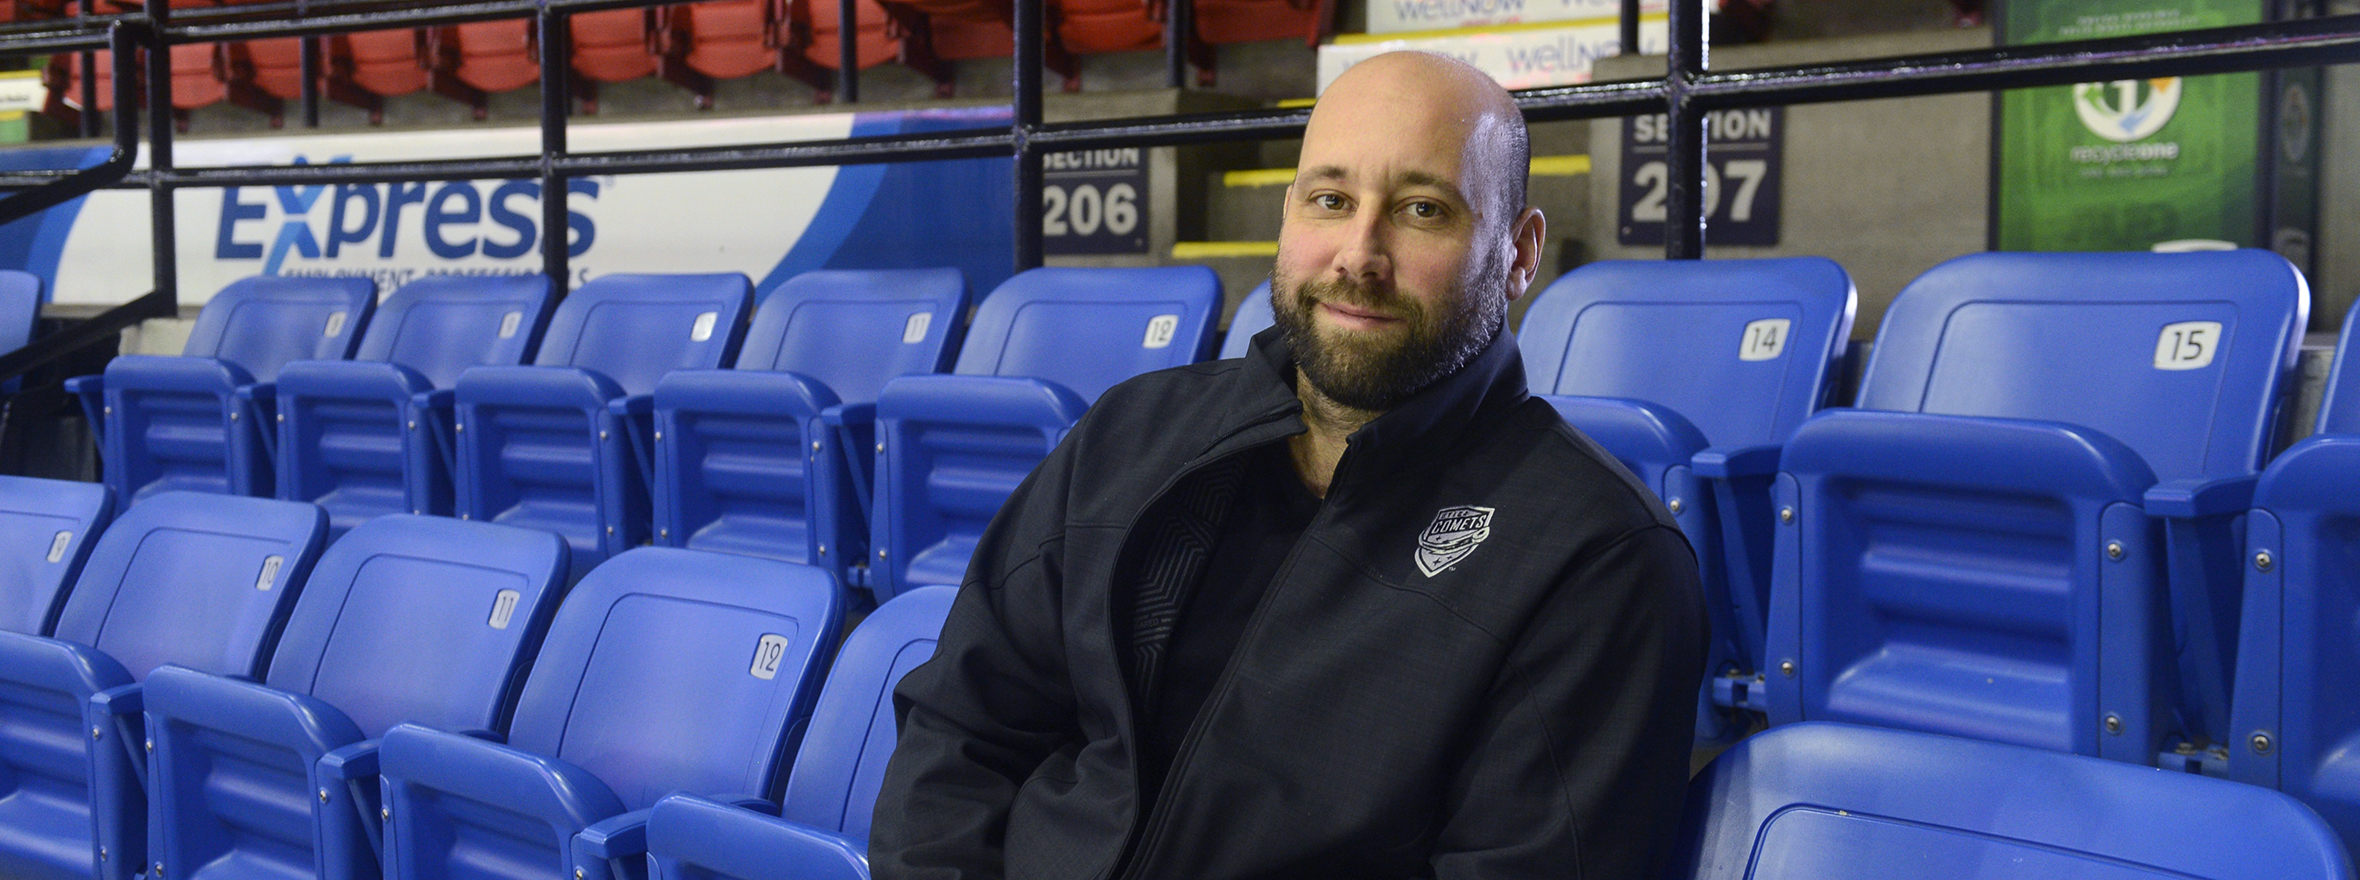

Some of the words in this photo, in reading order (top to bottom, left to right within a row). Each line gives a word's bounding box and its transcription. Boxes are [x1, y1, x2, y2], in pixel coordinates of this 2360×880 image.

[1505, 33, 1655, 73] wellN
[1634, 109, 1772, 143] SEION
[216, 155, 599, 276] Express
[1043, 183, 1138, 236] 206
[1151, 320, 1172, 342] 12
[1751, 326, 1777, 353] 14
[2172, 329, 2205, 361] 15
[1431, 514, 1487, 534] COMETS
[262, 560, 279, 584] 10
[497, 595, 514, 622] 11
[759, 641, 781, 672] 12
